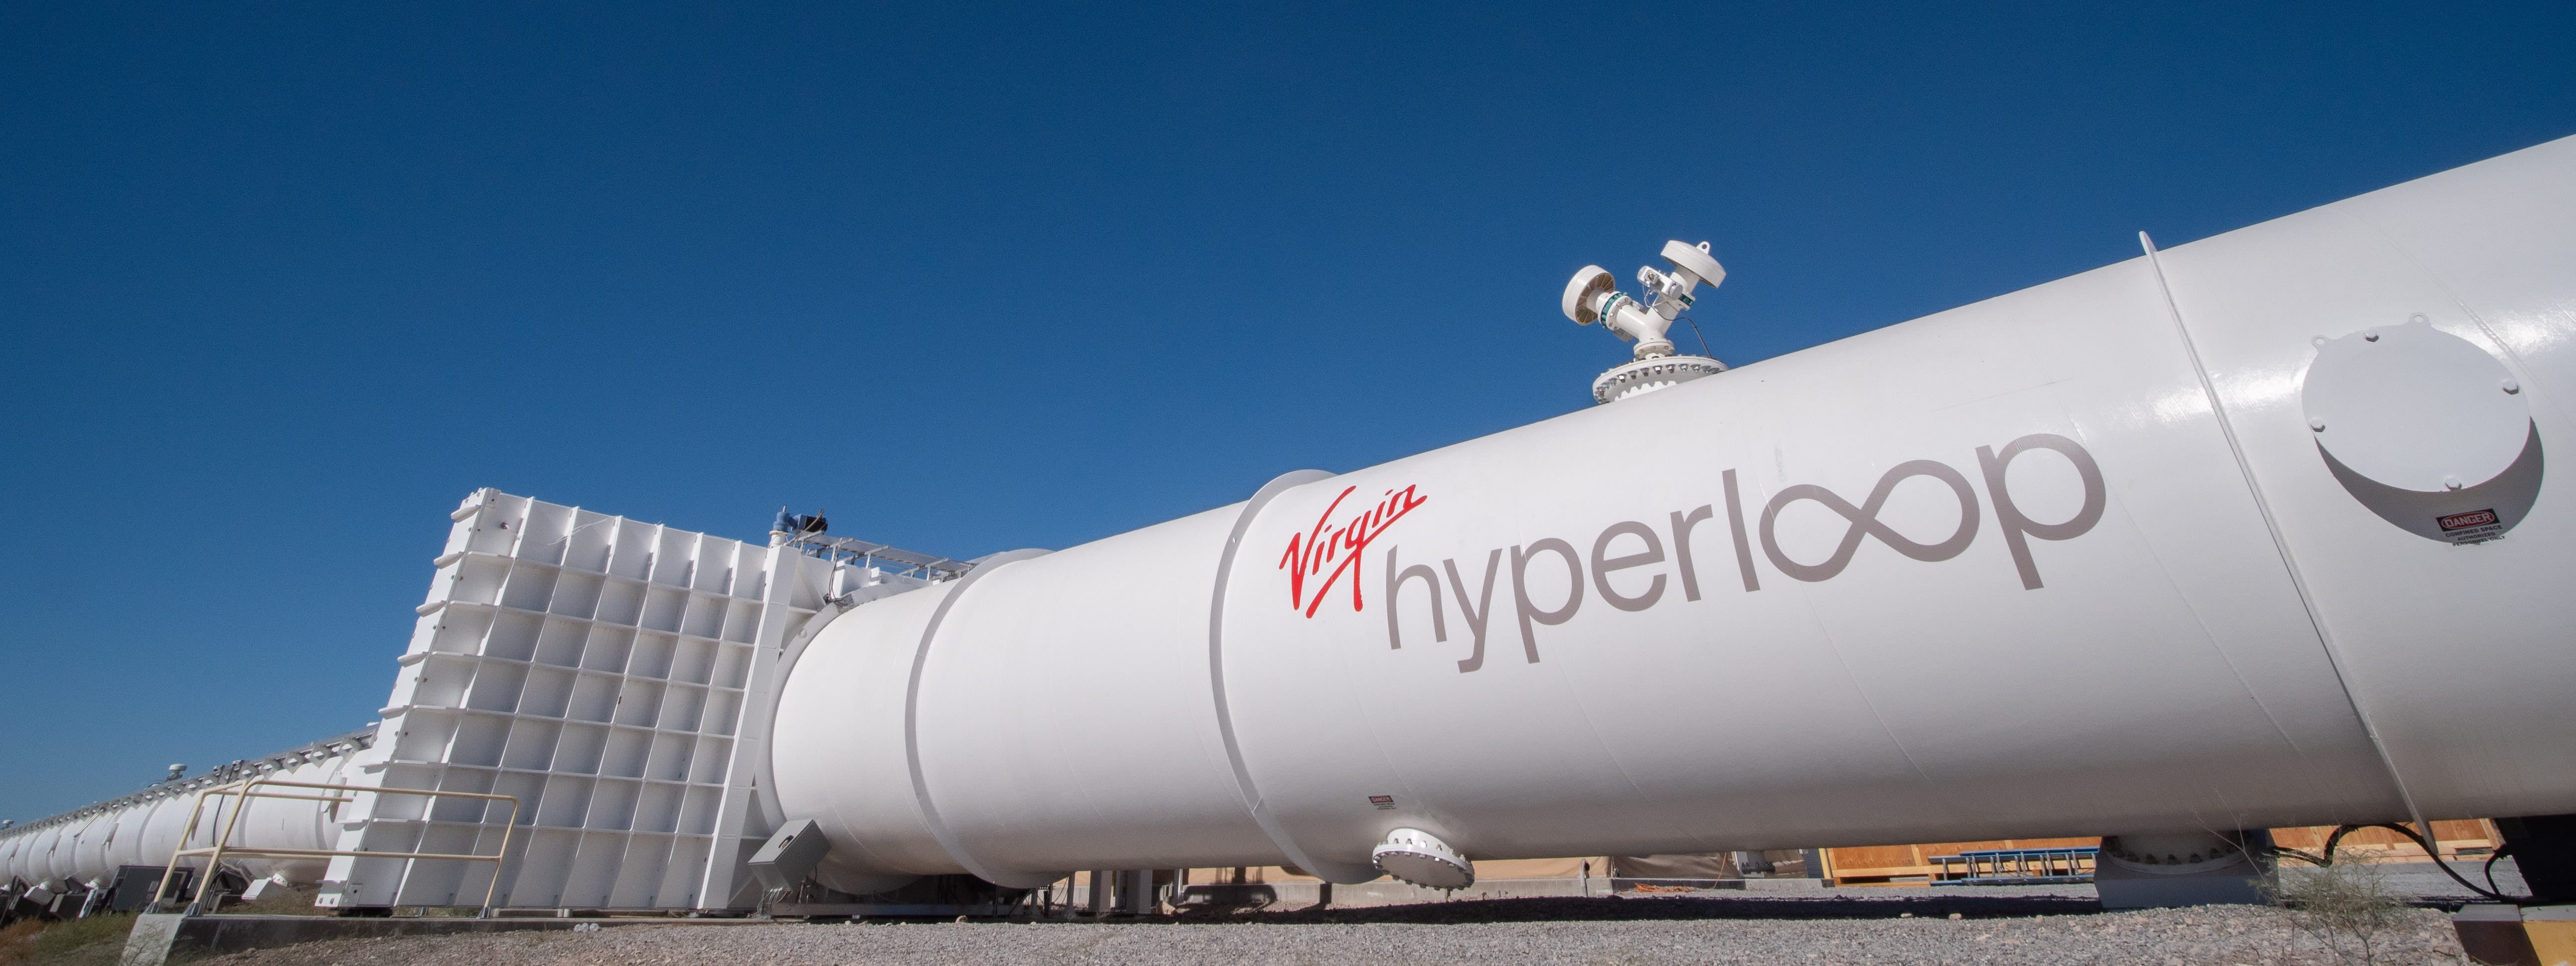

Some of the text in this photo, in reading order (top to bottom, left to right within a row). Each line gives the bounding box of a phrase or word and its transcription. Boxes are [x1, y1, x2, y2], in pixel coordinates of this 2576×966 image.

[2444, 513, 2492, 527] DANGER
[2445, 528, 2479, 538] CONFINED
[2457, 532, 2496, 541] AUTHORIZED
[1279, 484, 1427, 619] Virgin
[1385, 433, 2107, 673] hyperloop
